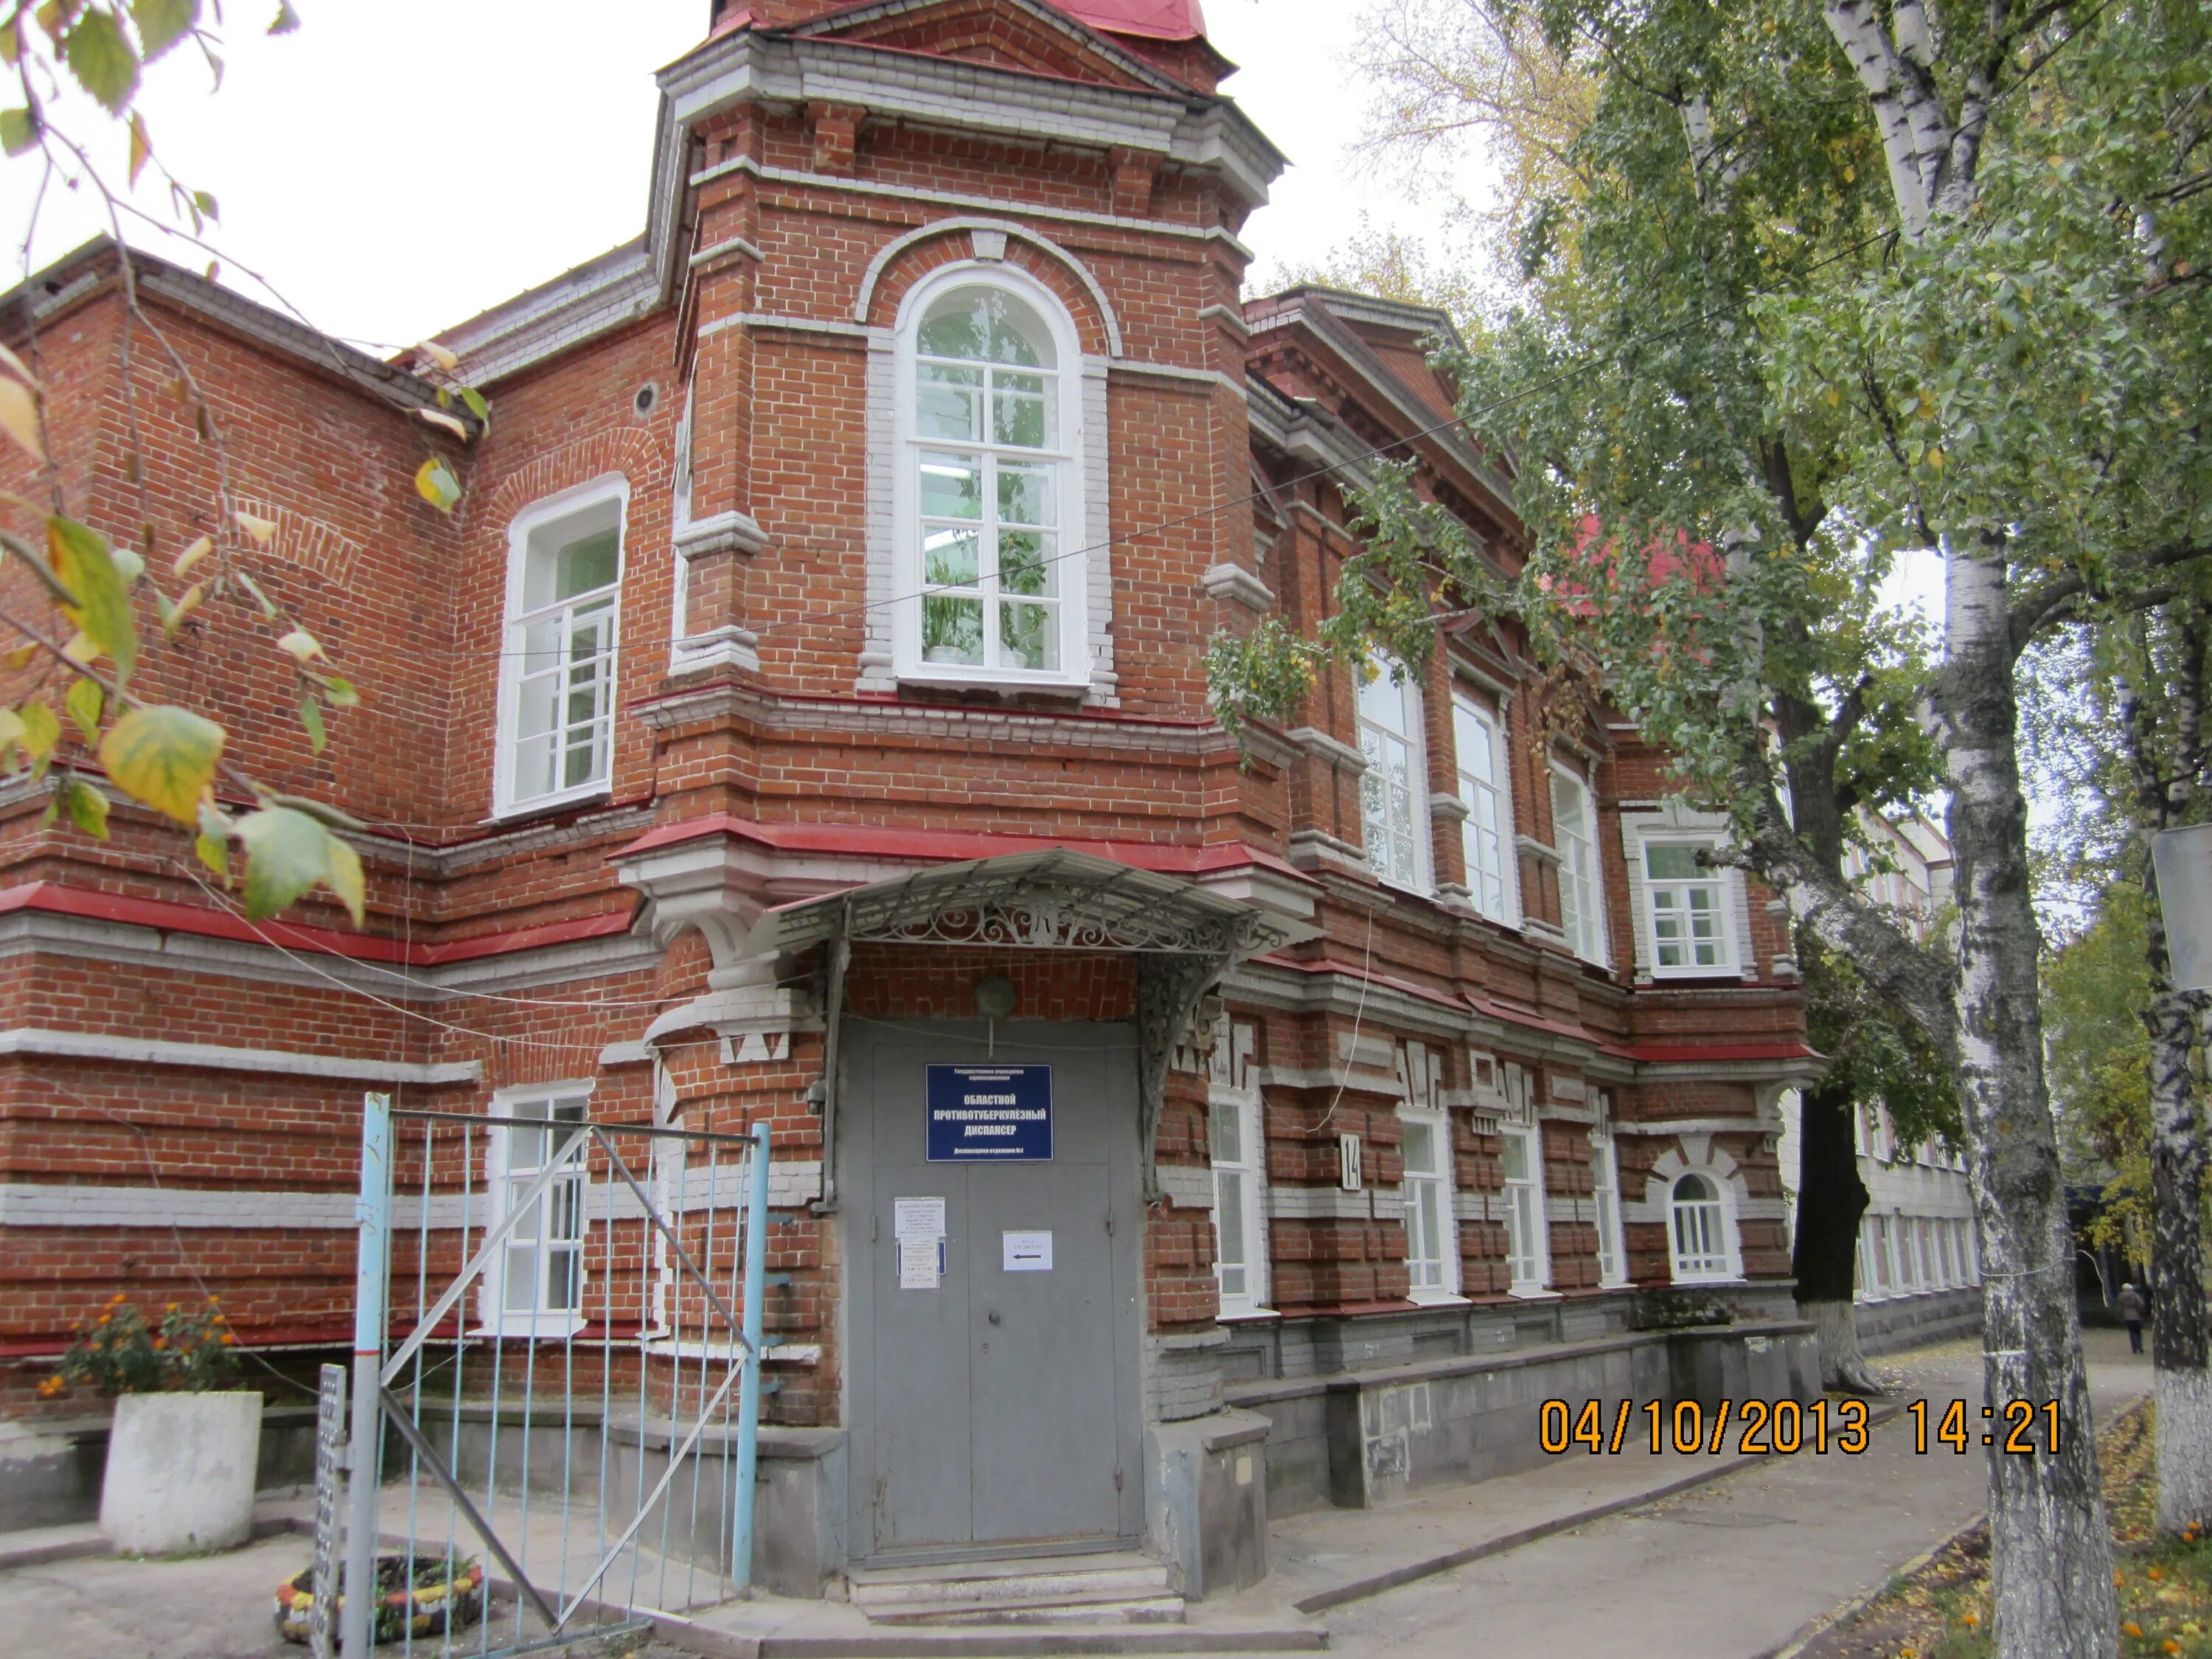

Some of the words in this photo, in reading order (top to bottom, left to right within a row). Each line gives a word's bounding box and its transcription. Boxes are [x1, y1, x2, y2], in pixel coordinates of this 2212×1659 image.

[964, 1093, 1016, 1105] ОБЛАСТНОЙ
[964, 1125, 1017, 1137] ДИСПАНСЕР
[1344, 1138, 1359, 1186] 14
